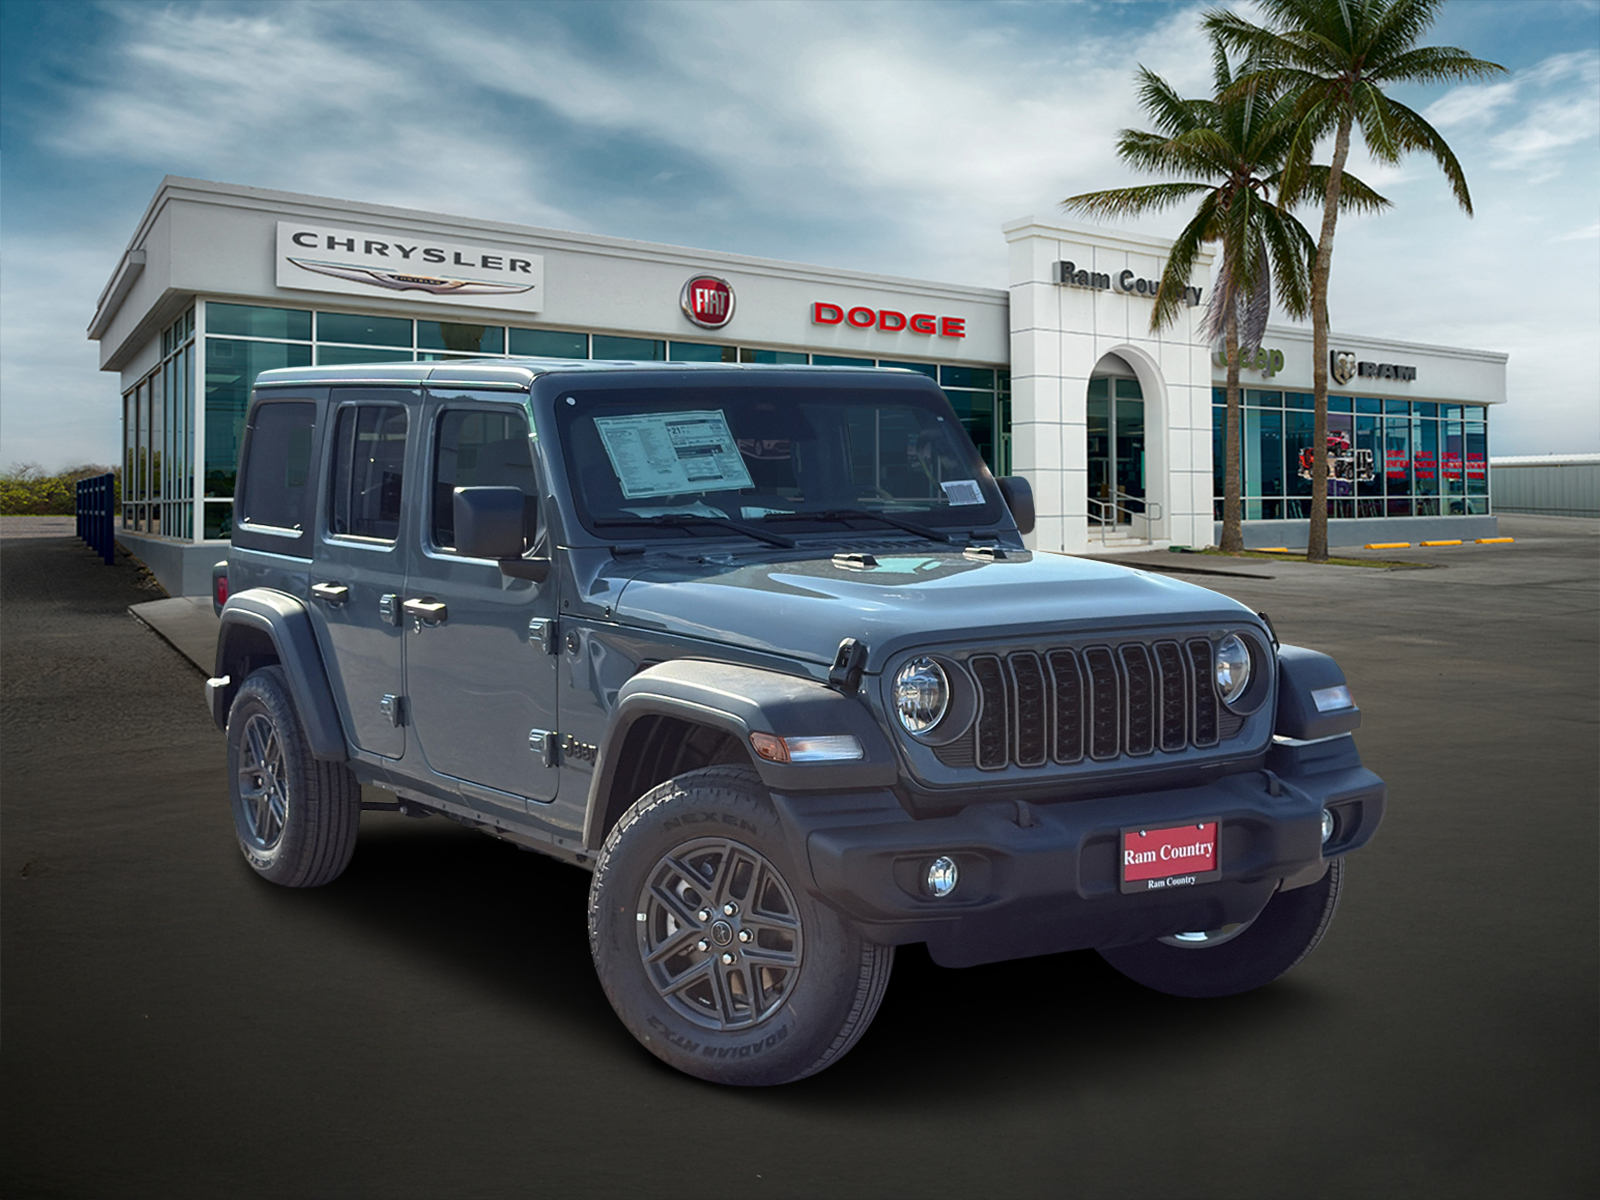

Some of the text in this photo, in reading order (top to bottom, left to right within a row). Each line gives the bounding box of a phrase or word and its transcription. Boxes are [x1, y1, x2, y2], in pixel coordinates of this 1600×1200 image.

[291, 231, 532, 274] CHRYSLER
[1055, 260, 1203, 306] Ram Coury
[695, 288, 728, 316] FIAT
[812, 301, 966, 338] DODGE
[1357, 361, 1417, 381] RAM
[663, 812, 758, 836] NEXEN
[1124, 842, 1214, 865] Ram Country
[1148, 876, 1196, 889] Ram Country
[701, 1023, 789, 1059] ROADIAN
